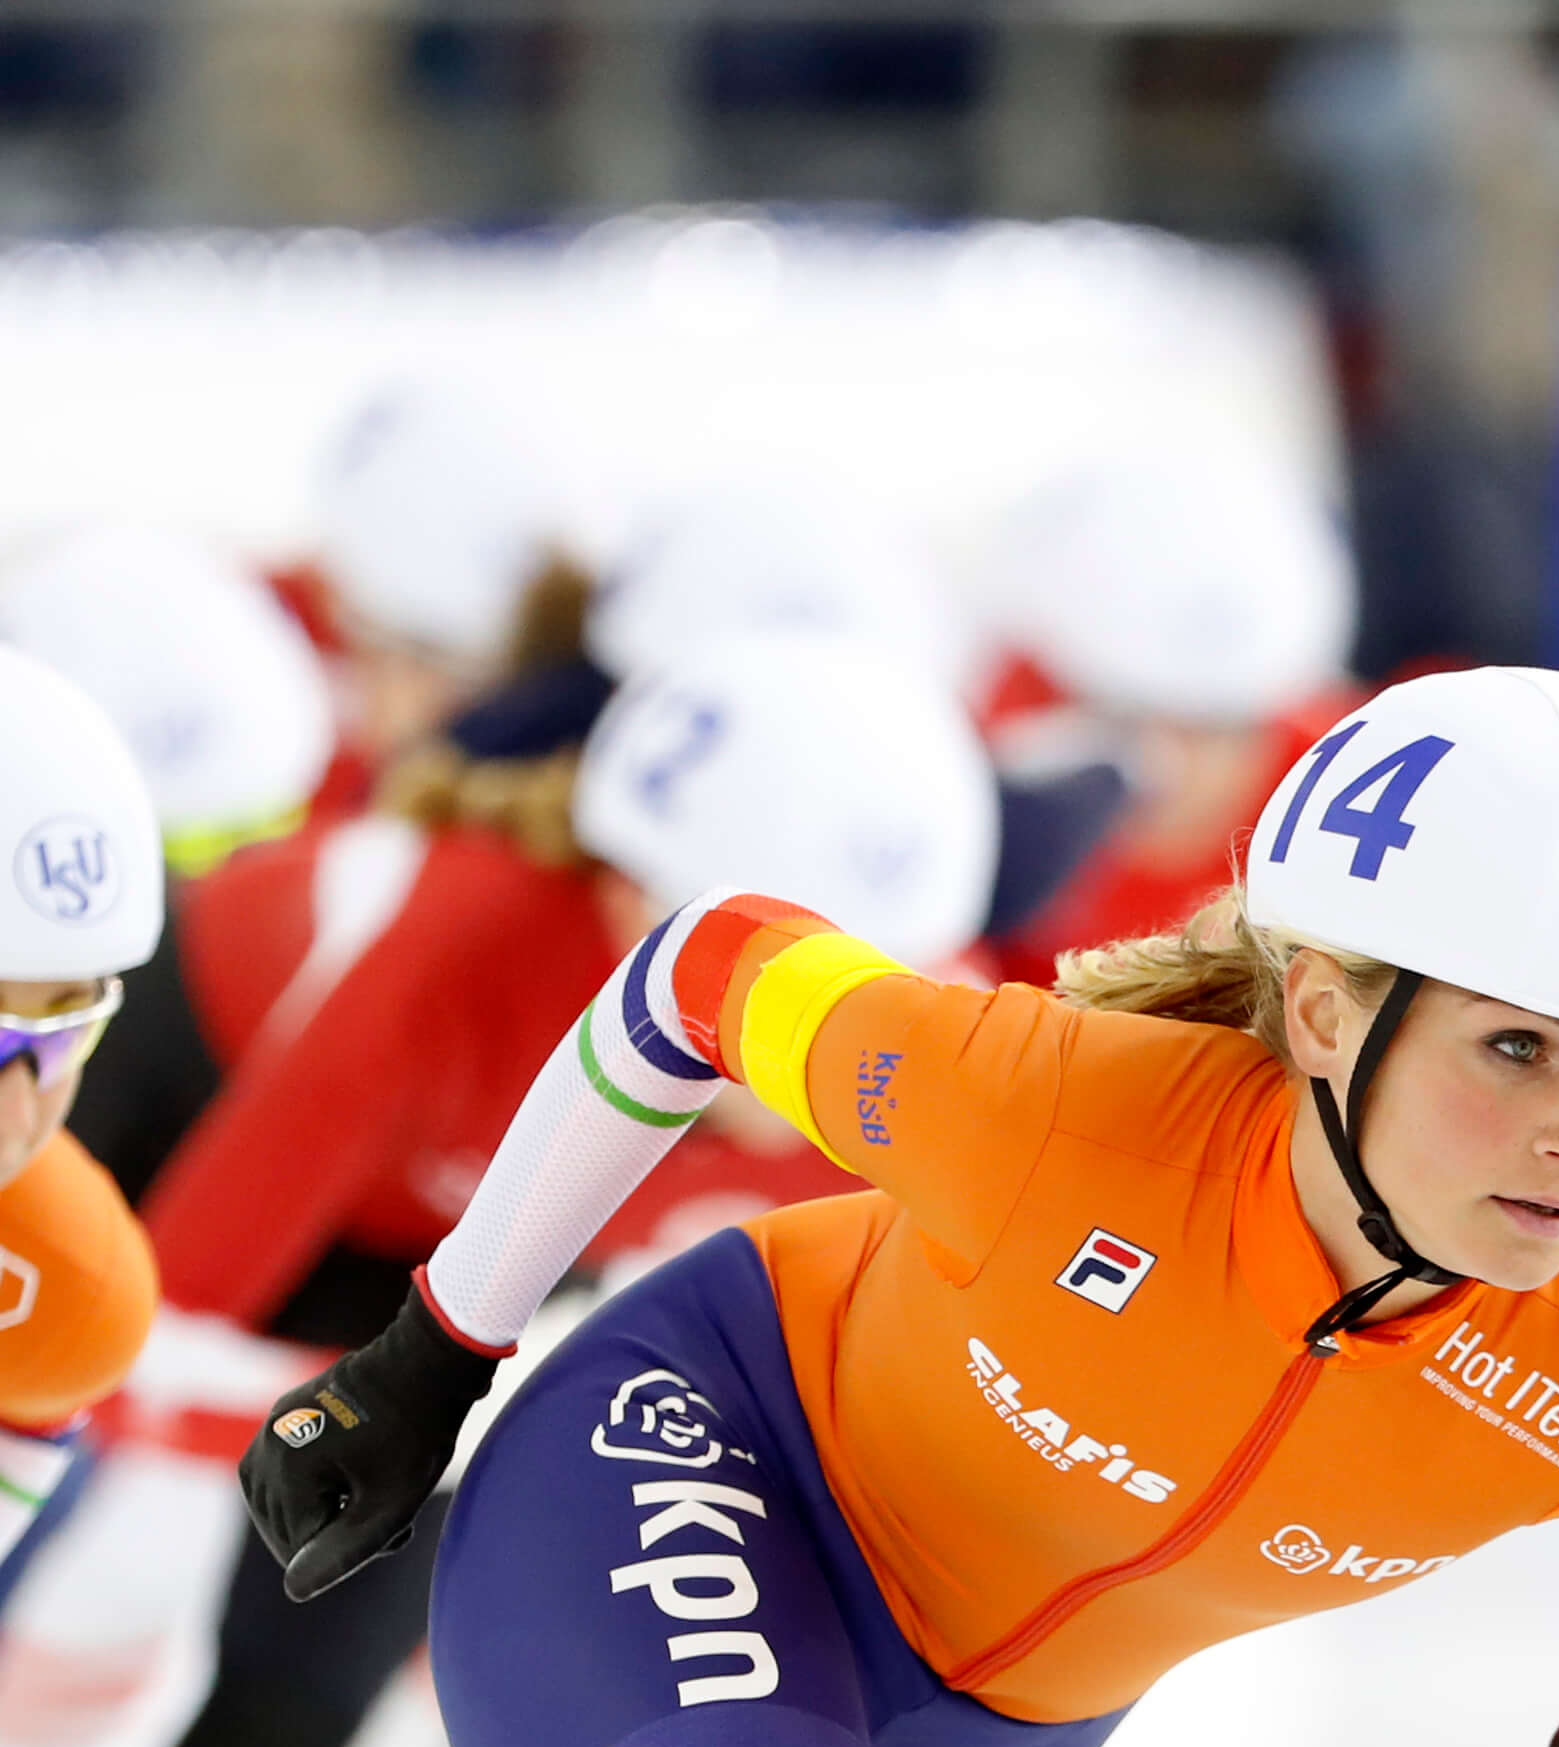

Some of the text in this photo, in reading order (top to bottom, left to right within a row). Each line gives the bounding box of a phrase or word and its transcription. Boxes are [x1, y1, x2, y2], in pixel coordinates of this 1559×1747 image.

[1268, 720, 1456, 882] 14
[1419, 1365, 1477, 1412] IMPROVING
[1474, 1404, 1505, 1428] YOUR
[1433, 1320, 1516, 1399] Hot
[609, 1480, 783, 1708] kpn
